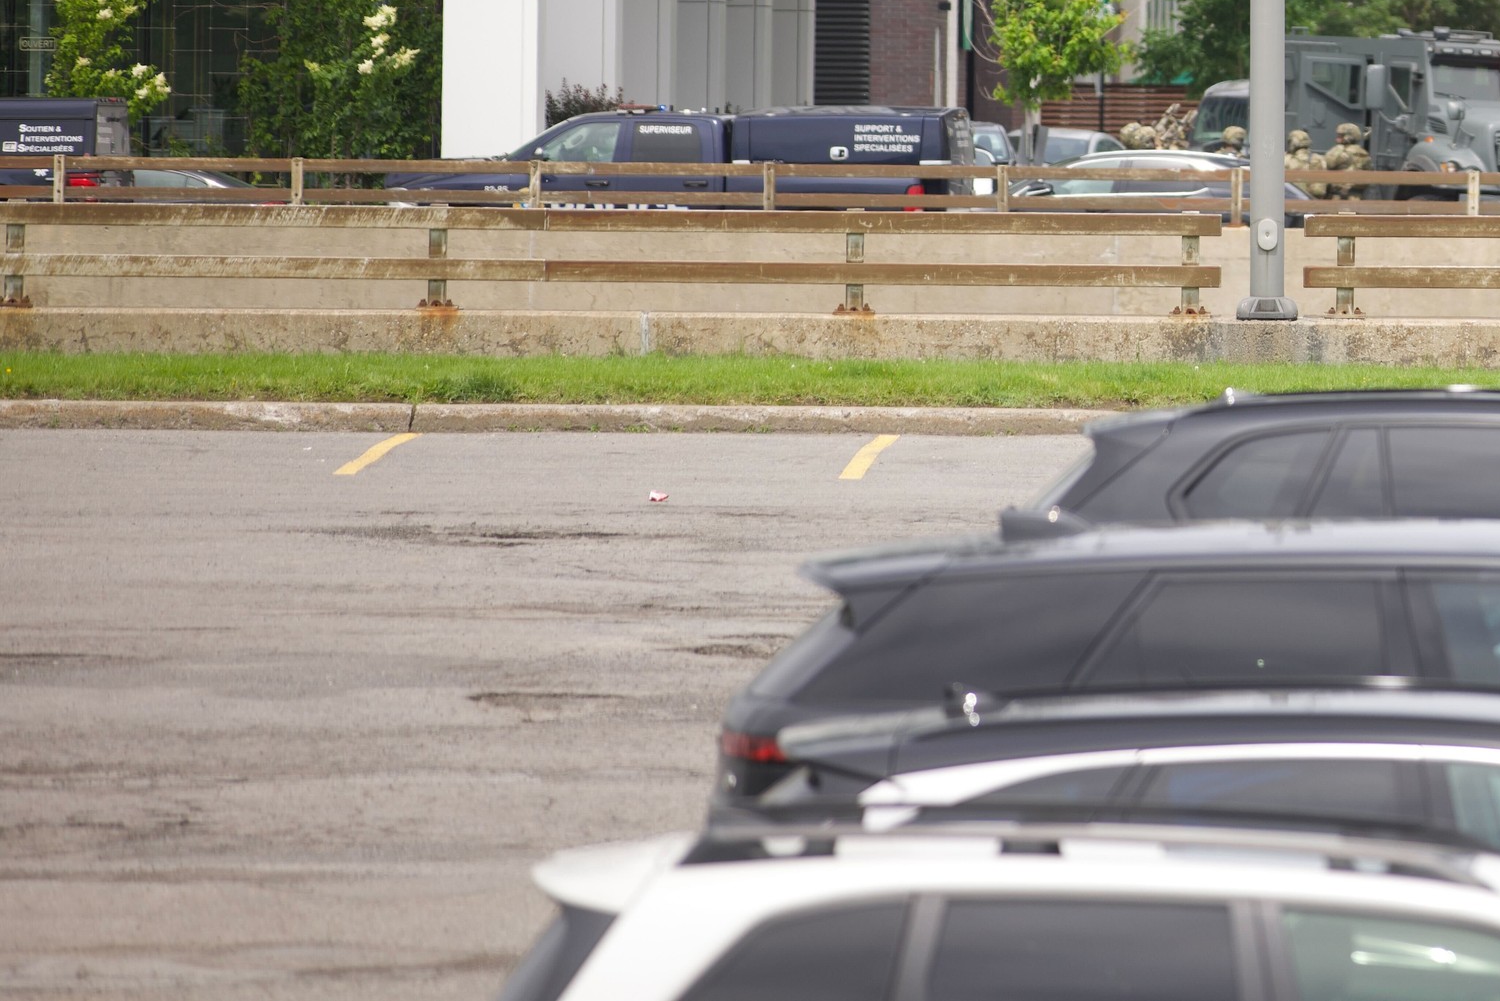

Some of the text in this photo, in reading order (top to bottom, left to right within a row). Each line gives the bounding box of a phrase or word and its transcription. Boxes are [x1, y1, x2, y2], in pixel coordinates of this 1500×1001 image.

[21, 39, 54, 49] OUVERT
[19, 124, 54, 132] SOUTIEN
[639, 125, 693, 135] SUPERVISEUR
[854, 124, 903, 134] SUPPORT &
[20, 134, 83, 142] INTERVENTIONS
[854, 134, 921, 144] INTERVENTIONS
[18, 143, 74, 152] SPÉCIALISÉES
